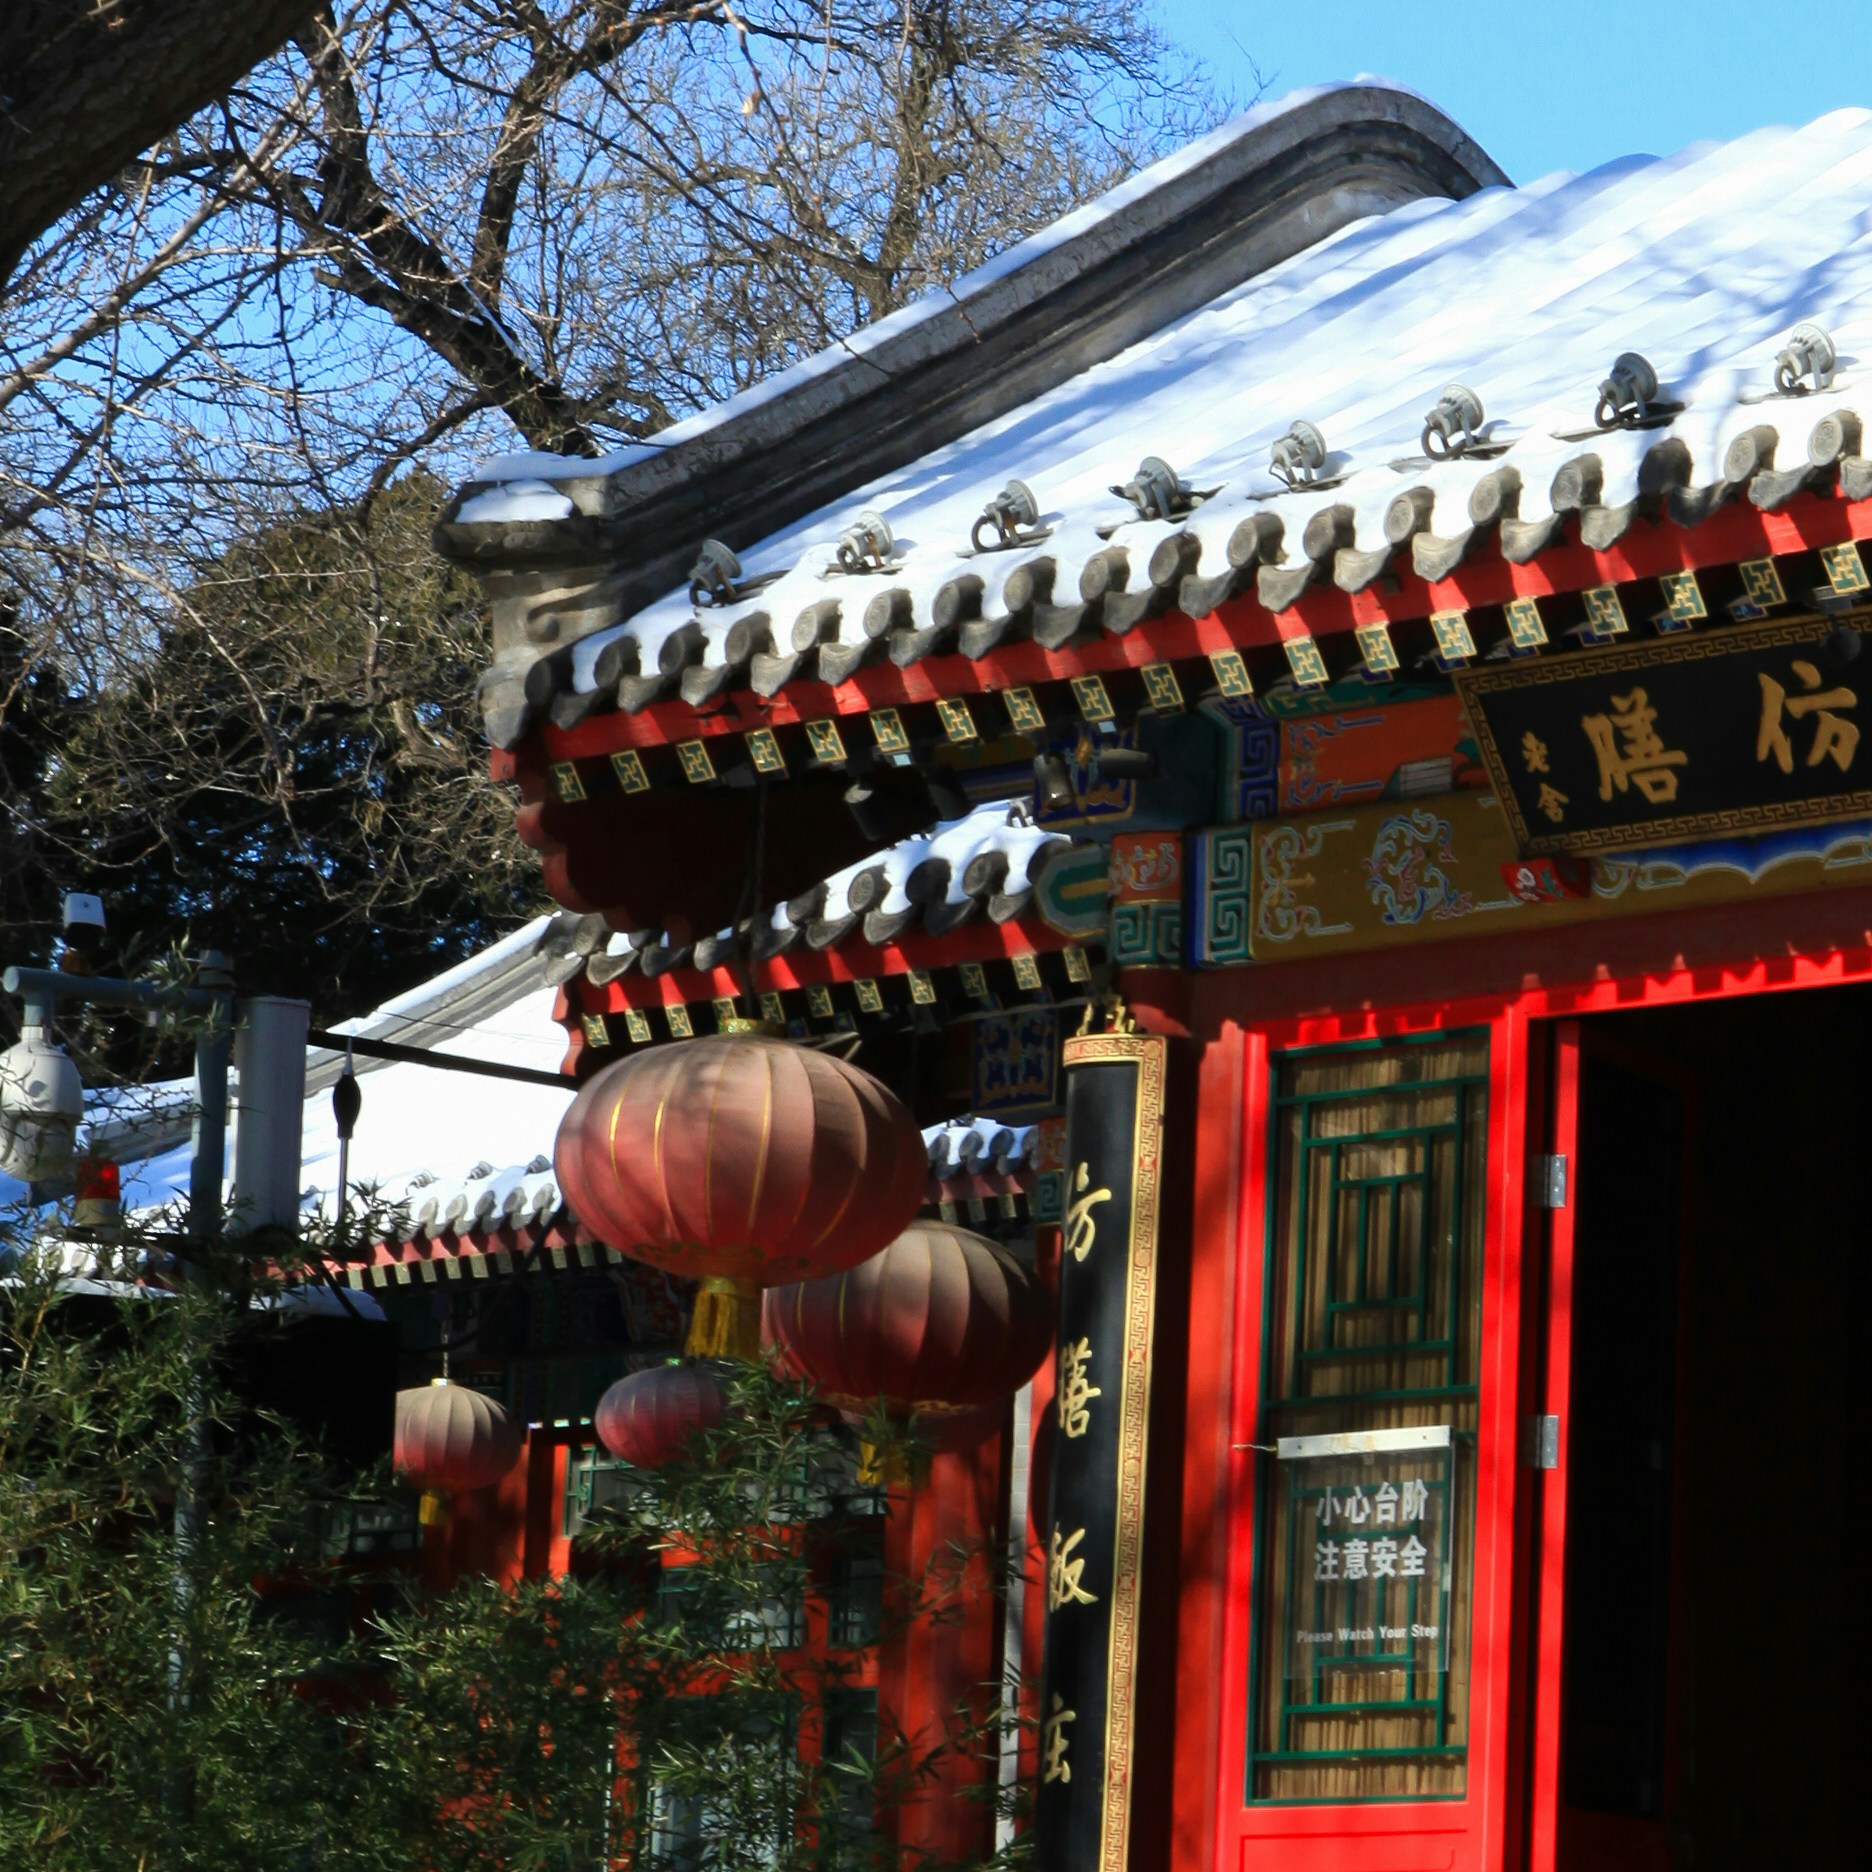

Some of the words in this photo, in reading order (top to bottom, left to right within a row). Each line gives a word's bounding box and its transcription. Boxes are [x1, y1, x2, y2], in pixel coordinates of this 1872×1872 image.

[1581, 660, 1861, 804] 仿膳
[1315, 1478, 1429, 1526] 小心台阶
[1314, 1534, 1428, 1581] 注意安全
[1297, 1629, 1333, 1644] Please
[1338, 1626, 1375, 1642] Watch
[1378, 1625, 1408, 1639] Your
[1411, 1623, 1439, 1640] Step
